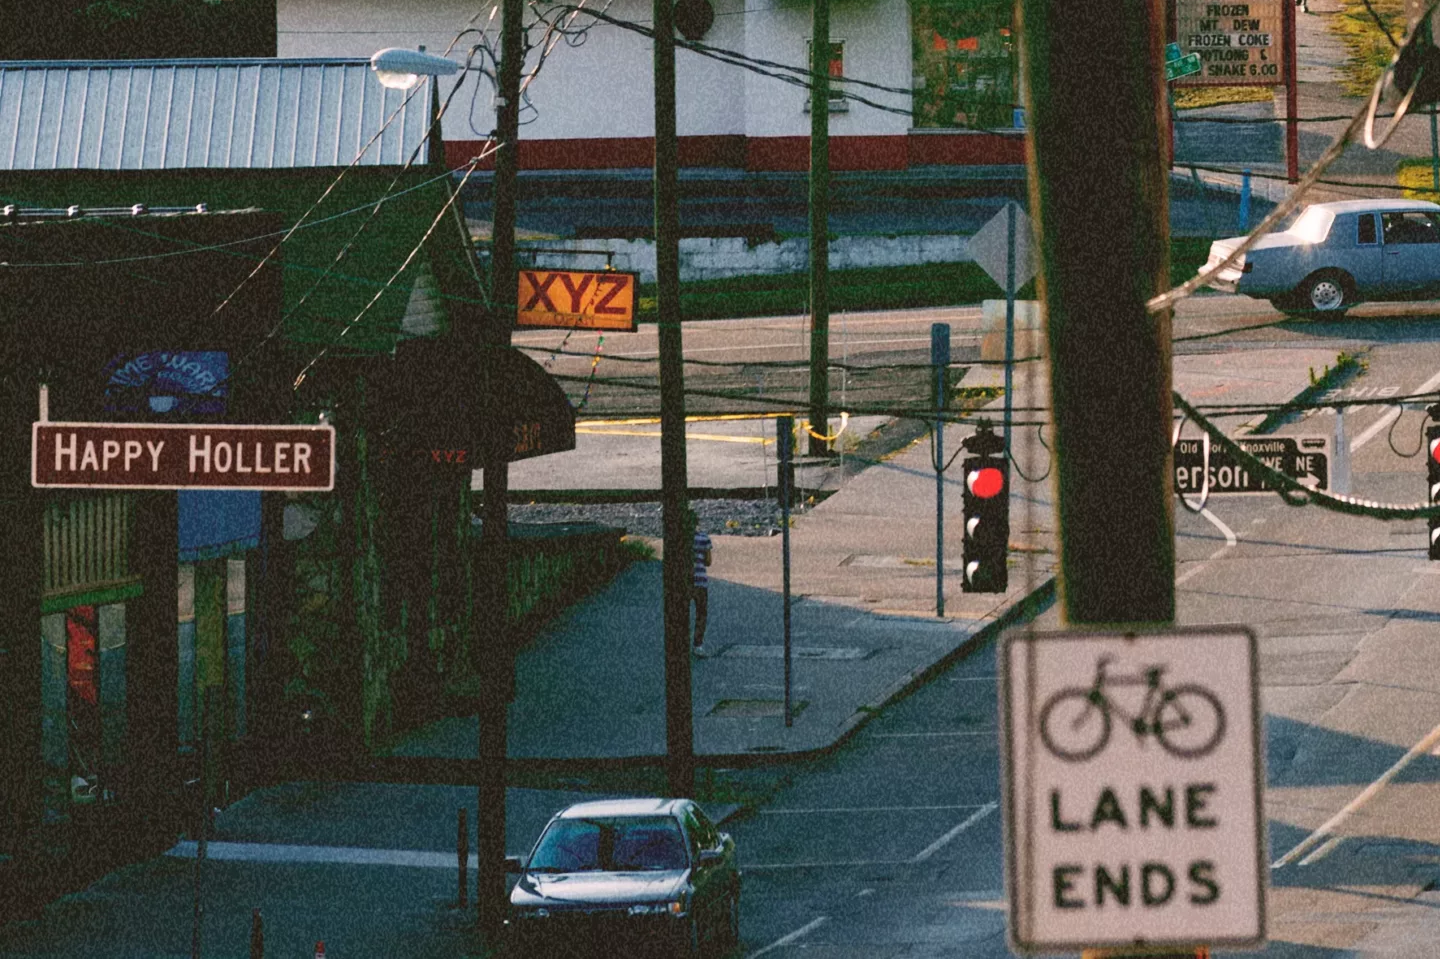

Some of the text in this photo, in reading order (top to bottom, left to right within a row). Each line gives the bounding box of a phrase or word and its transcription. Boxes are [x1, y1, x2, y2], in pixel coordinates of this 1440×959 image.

[1206, 4, 1250, 16] FROZEN
[1233, 19, 1260, 31] DEW
[1188, 34, 1270, 46] FROZEN COKE
[1249, 63, 1278, 76] 6.00
[521, 271, 629, 315] XYZ
[54, 433, 312, 473] HAPPY HOLLER
[1180, 442, 1198, 453] Old
[1296, 456, 1314, 472] NE
[1176, 465, 1249, 489] erson
[1050, 782, 1219, 832] LANE
[1053, 860, 1221, 909] ENDS
